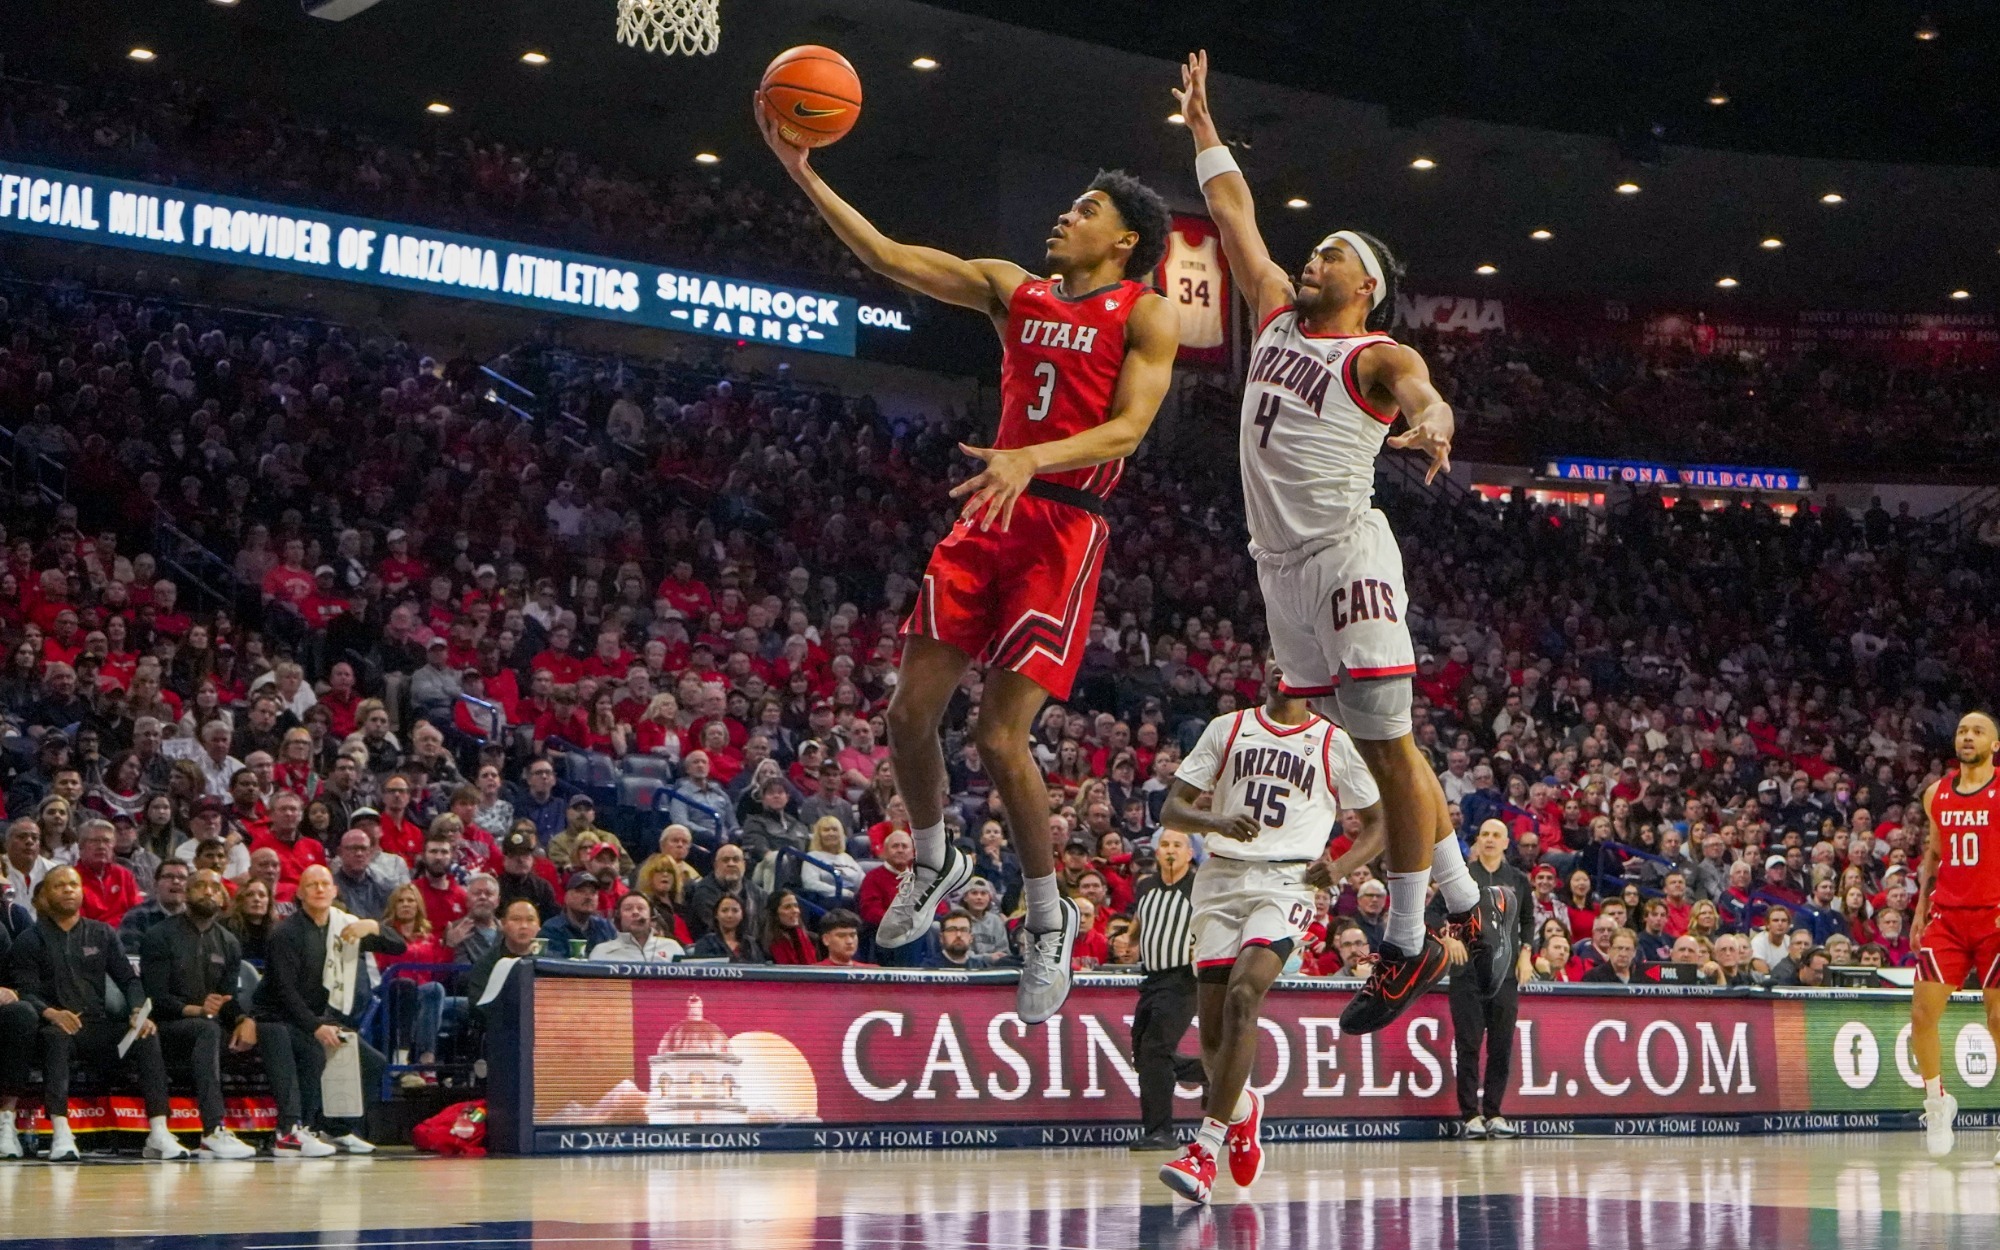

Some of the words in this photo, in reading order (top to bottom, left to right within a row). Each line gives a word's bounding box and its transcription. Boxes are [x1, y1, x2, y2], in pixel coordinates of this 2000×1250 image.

[0, 173, 100, 230] FICIAL
[108, 191, 185, 243] MILK
[193, 203, 331, 265] PROVIDER
[337, 228, 377, 270] OF
[380, 234, 499, 291] ARIZONA
[502, 253, 640, 313] ATHLETICS
[656, 273, 839, 326] SHAMROCK
[1179, 277, 1210, 308] 34
[693, 308, 803, 343] FARMS
[857, 305, 911, 331] GOAL.
[1391, 293, 1506, 333] NCAA
[1020, 319, 1098, 353] UTAH
[1027, 361, 1056, 421] 3
[1251, 346, 1333, 419] ARIZONA
[1254, 391, 1281, 449] 4
[1678, 469, 1789, 490] WILDCATS
[1331, 578, 1398, 632] CATS
[1233, 747, 1316, 801] ARIZONA
[1244, 781, 1290, 828] 45
[1940, 810, 1989, 826] UTAH
[1950, 832, 1979, 867] 10
[1288, 902, 1313, 932] CA
[657, 965, 697, 976] HOME
[702, 967, 744, 978] LOANS
[890, 973, 926, 982] HOME
[932, 973, 970, 982] LOANS
[68, 1107, 105, 1118] ARGO
[113, 1107, 148, 1118] WELL
[171, 1108, 199, 1118] RGO
[254, 1107, 278, 1118] FAR
[1660, 1119, 1697, 1132] HOME
[1702, 1120, 1740, 1132] LOANS
[1805, 1114, 1839, 1128] HOME
[1844, 1114, 1879, 1127] LOANS
[1957, 1113, 1988, 1126] HOME
[633, 1132, 691, 1148] HOME
[701, 1132, 761, 1148] LOANS
[880, 1131, 933, 1146] HOME
[942, 1130, 997, 1144] LOANS
[1265, 1125, 1300, 1140] OVA
[1304, 1123, 1349, 1138] HOME
[1355, 1122, 1400, 1137] LOANS
[1508, 1120, 1527, 1134] ME
[1533, 1120, 1575, 1134] LOANS
